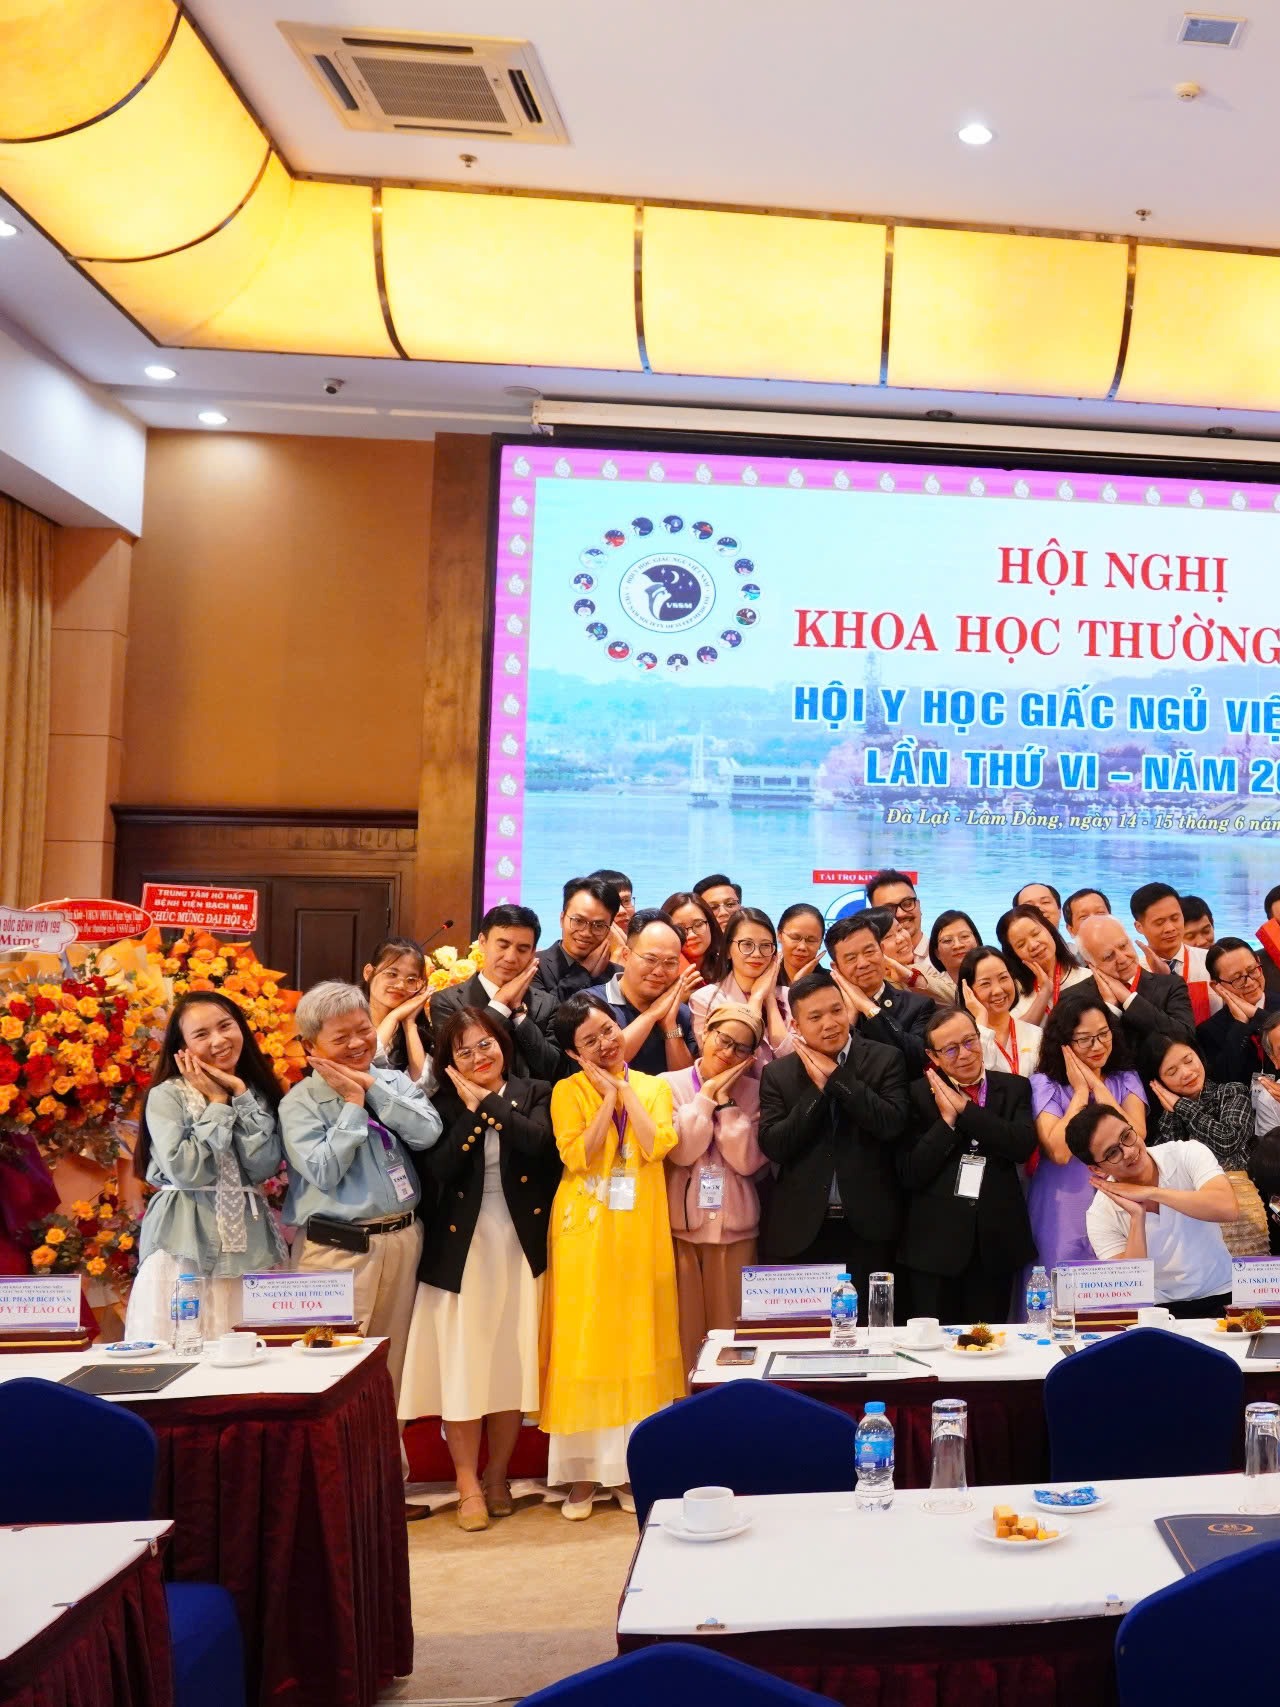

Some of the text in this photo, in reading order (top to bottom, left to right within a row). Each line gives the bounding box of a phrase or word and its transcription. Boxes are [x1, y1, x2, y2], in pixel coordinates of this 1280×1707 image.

[997, 537, 1229, 603] HỘI NGHỊ
[793, 609, 938, 651] KHOA
[955, 615, 1060, 664] HỌC
[794, 680, 864, 730] HỘI
[881, 689, 906, 723] Y
[923, 690, 1005, 733] HỌC
[1021, 684, 1114, 729] GIẤC
[1130, 686, 1207, 732] NGỦ
[865, 737, 948, 785] LẦN
[965, 745, 1045, 787] THỨ
[1060, 754, 1098, 788] VI
[1144, 752, 1237, 792] NĂM
[886, 808, 913, 824] Đà
[918, 811, 949, 827] Lạt
[966, 810, 1007, 826] Lâm
[1011, 808, 1063, 830] Đồng,
[1070, 813, 1112, 831] ngày
[1119, 814, 1137, 828] 14
[1155, 814, 1173, 829] 15
[1178, 814, 1229, 833] tháng
[1235, 816, 1245, 831] 6
[859, 873, 874, 881] KIN
[158, 889, 188, 897] TRUNG
[189, 890, 209, 898] TÂM
[226, 891, 245, 900] HẤP
[154, 898, 180, 907] BỆNH
[182, 899, 203, 908] VIỆN
[231, 903, 249, 911] MAI
[3, 915, 15, 932] ĐỐC
[17, 916, 33, 934] BỆNH
[34, 917, 49, 934] VIỆN
[50, 921, 60, 933] 199
[150, 908, 241, 927] CHÚC MỪNG ĐẠI HỘI
[773, 1288, 797, 1296] PHẠM
[1080, 1280, 1144, 1289] THOMAS PENZEL
[7, 1305, 12, 1313] Y
[301, 1300, 323, 1310] TỌA
